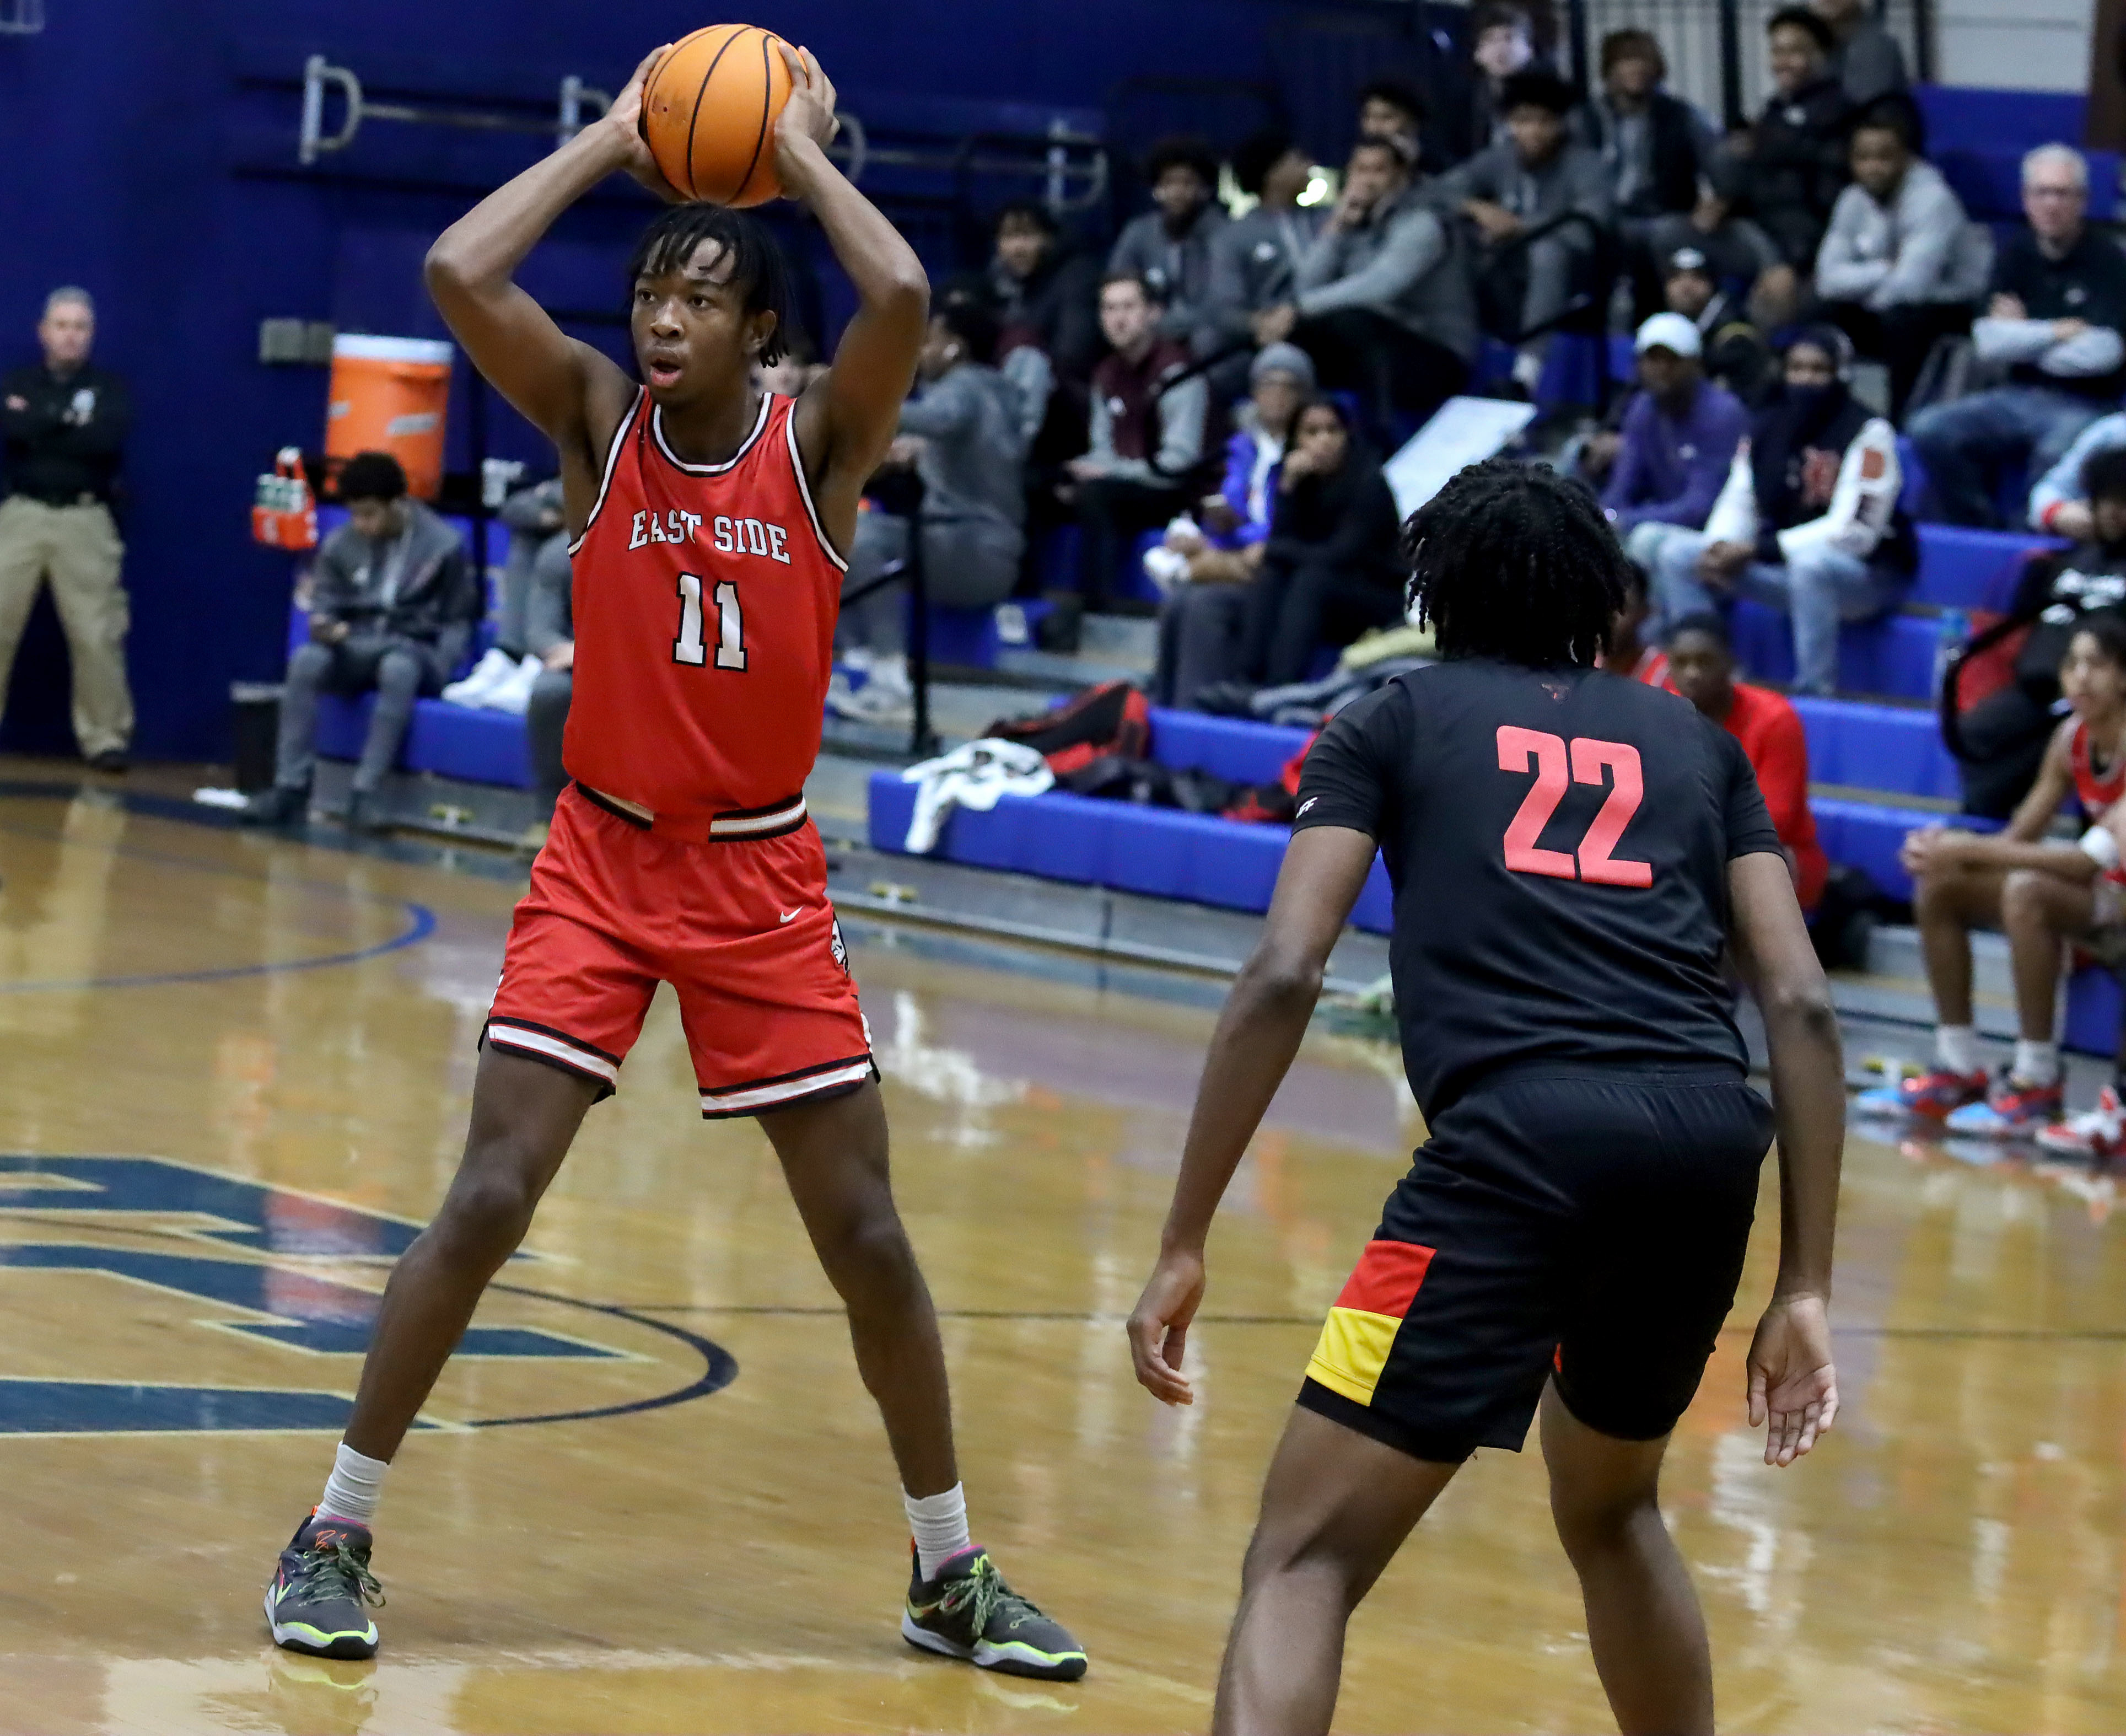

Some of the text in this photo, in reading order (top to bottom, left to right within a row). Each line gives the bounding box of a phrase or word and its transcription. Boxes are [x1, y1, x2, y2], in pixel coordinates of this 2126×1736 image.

[628, 509, 791, 565] EAST SIDE
[672, 572, 748, 672] 11
[1496, 725, 1653, 889] 22
